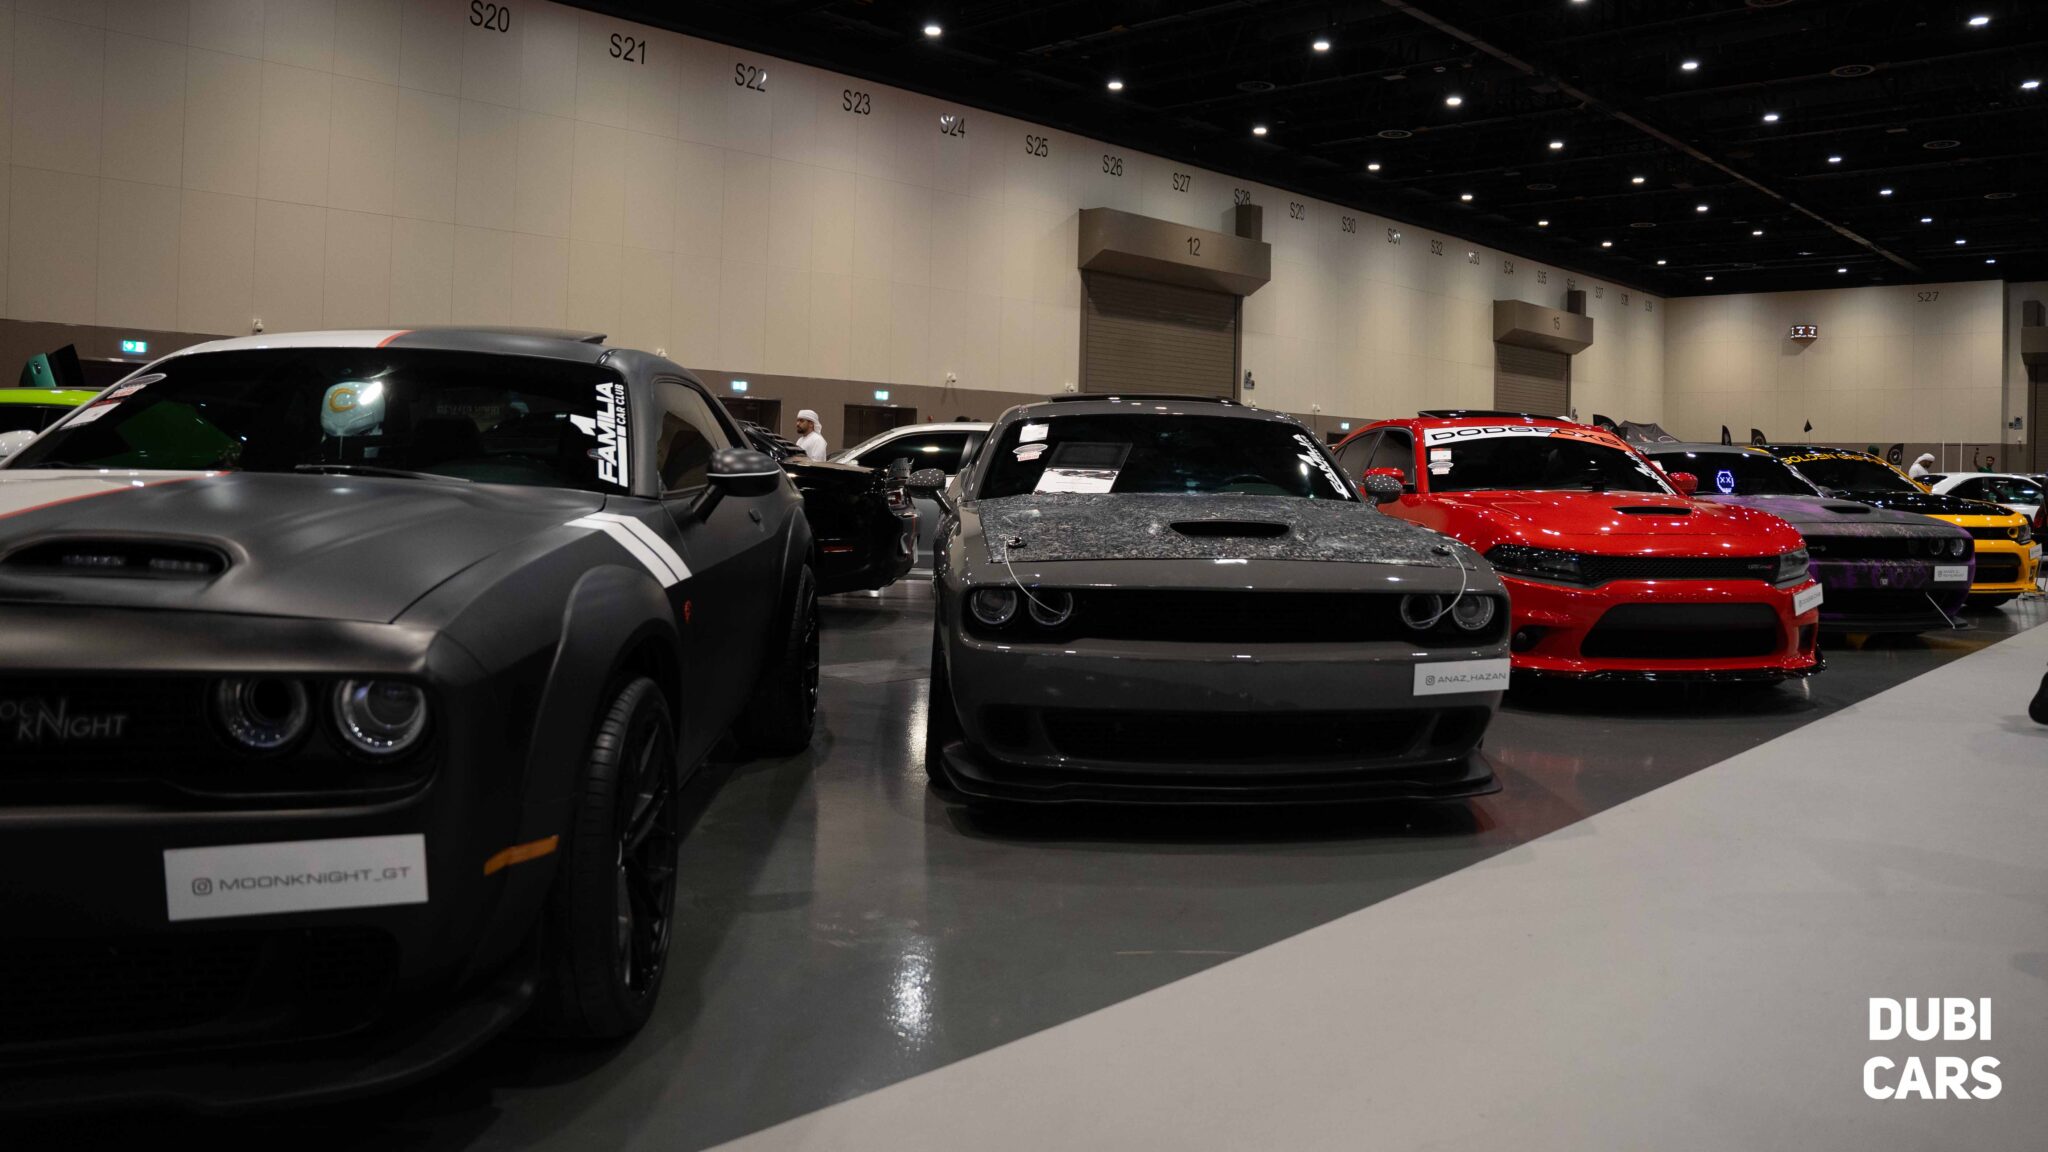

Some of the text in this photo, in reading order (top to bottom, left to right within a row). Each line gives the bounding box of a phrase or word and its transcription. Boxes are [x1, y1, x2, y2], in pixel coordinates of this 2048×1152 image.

[469, 0, 510, 33] S20
[609, 33, 647, 65] S21
[734, 63, 767, 92] S22
[842, 90, 871, 116] S23
[1025, 134, 1049, 158] S25
[1102, 155, 1123, 177] S26
[1172, 173, 1191, 193] S27
[1234, 188, 1251, 207] S28
[1341, 215, 1356, 234] S30
[1186, 236, 1201, 256] 12
[1431, 239, 1443, 256] S32
[1917, 291, 1939, 303] S27
[1553, 316, 1561, 331] 15
[614, 383, 627, 425] CAR CLUB
[595, 381, 618, 484] FAMILIA
[219, 865, 411, 892] MOONKNIGHT_GT
